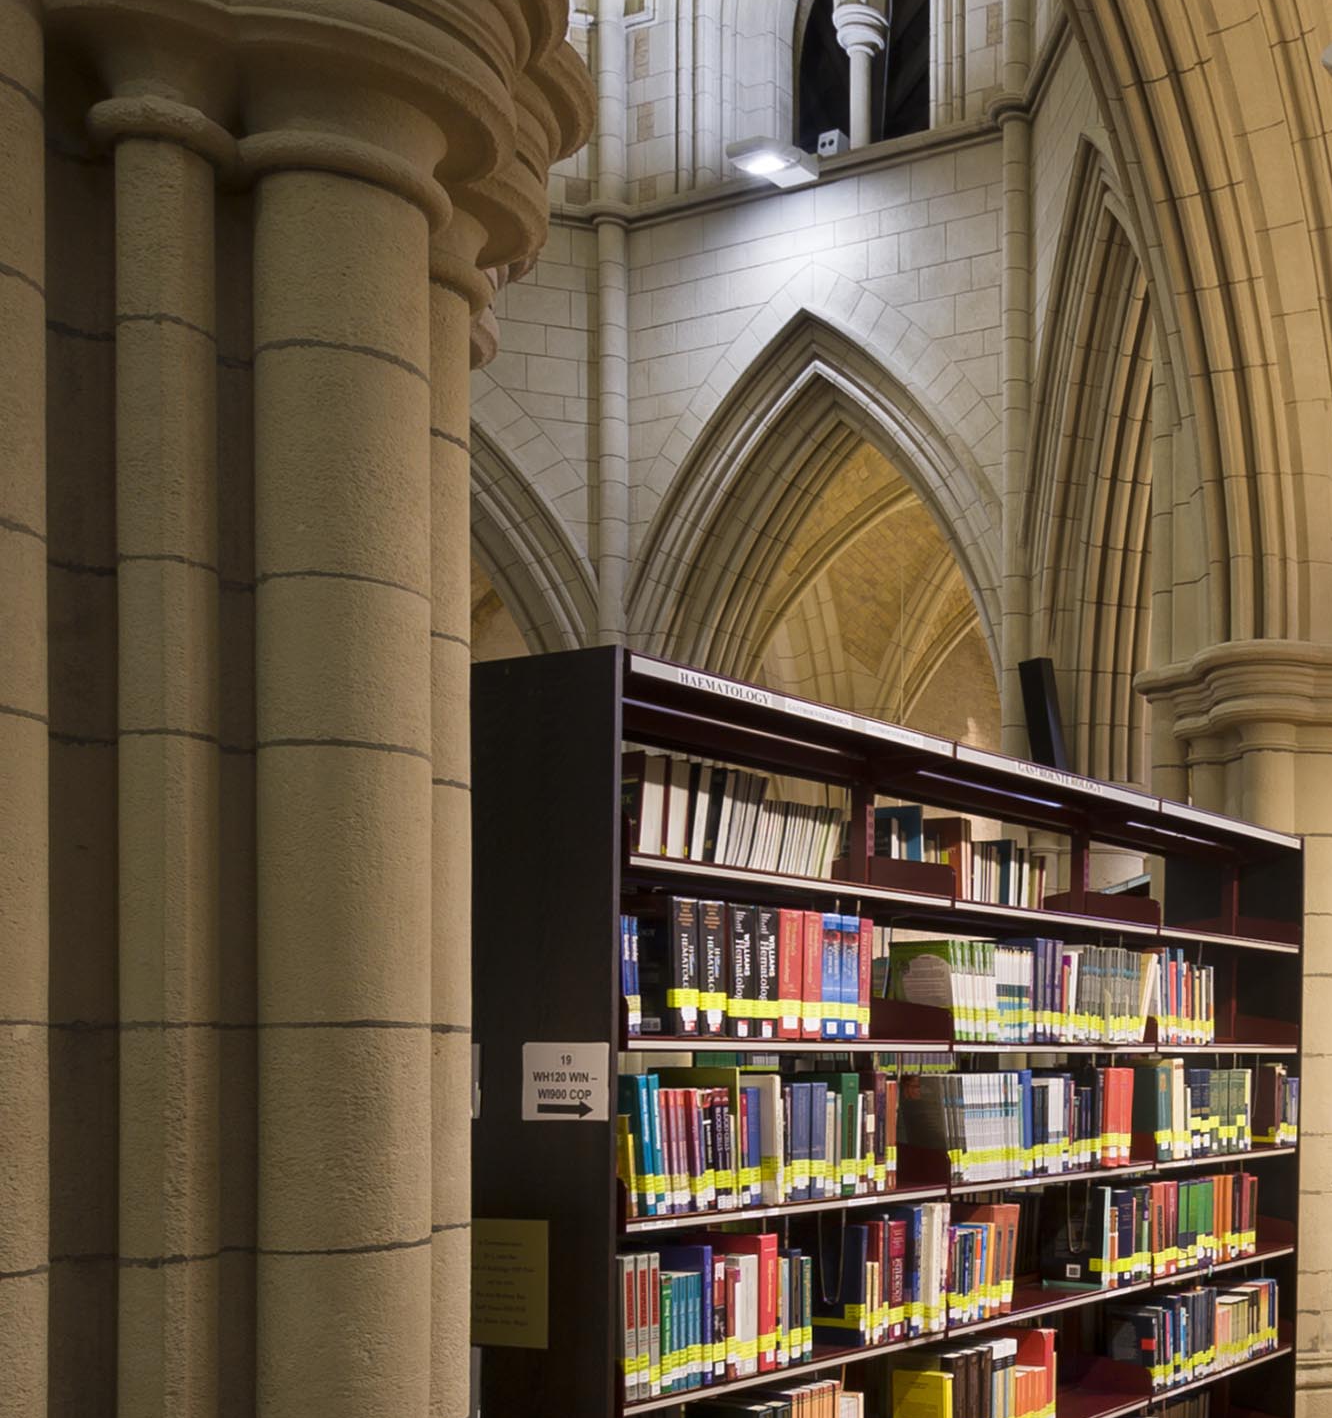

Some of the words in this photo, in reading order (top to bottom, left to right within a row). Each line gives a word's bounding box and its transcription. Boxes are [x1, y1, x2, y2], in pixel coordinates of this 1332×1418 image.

[680, 672, 770, 706] HAEMATOLOGY
[768, 934, 776, 978] WILLIAMS
[560, 1054, 572, 1065] 19
[532, 1071, 567, 1082] WH120
[568, 1071, 589, 1082] WIN
[537, 1088, 567, 1099] WI900
[569, 1089, 592, 1100] COP
